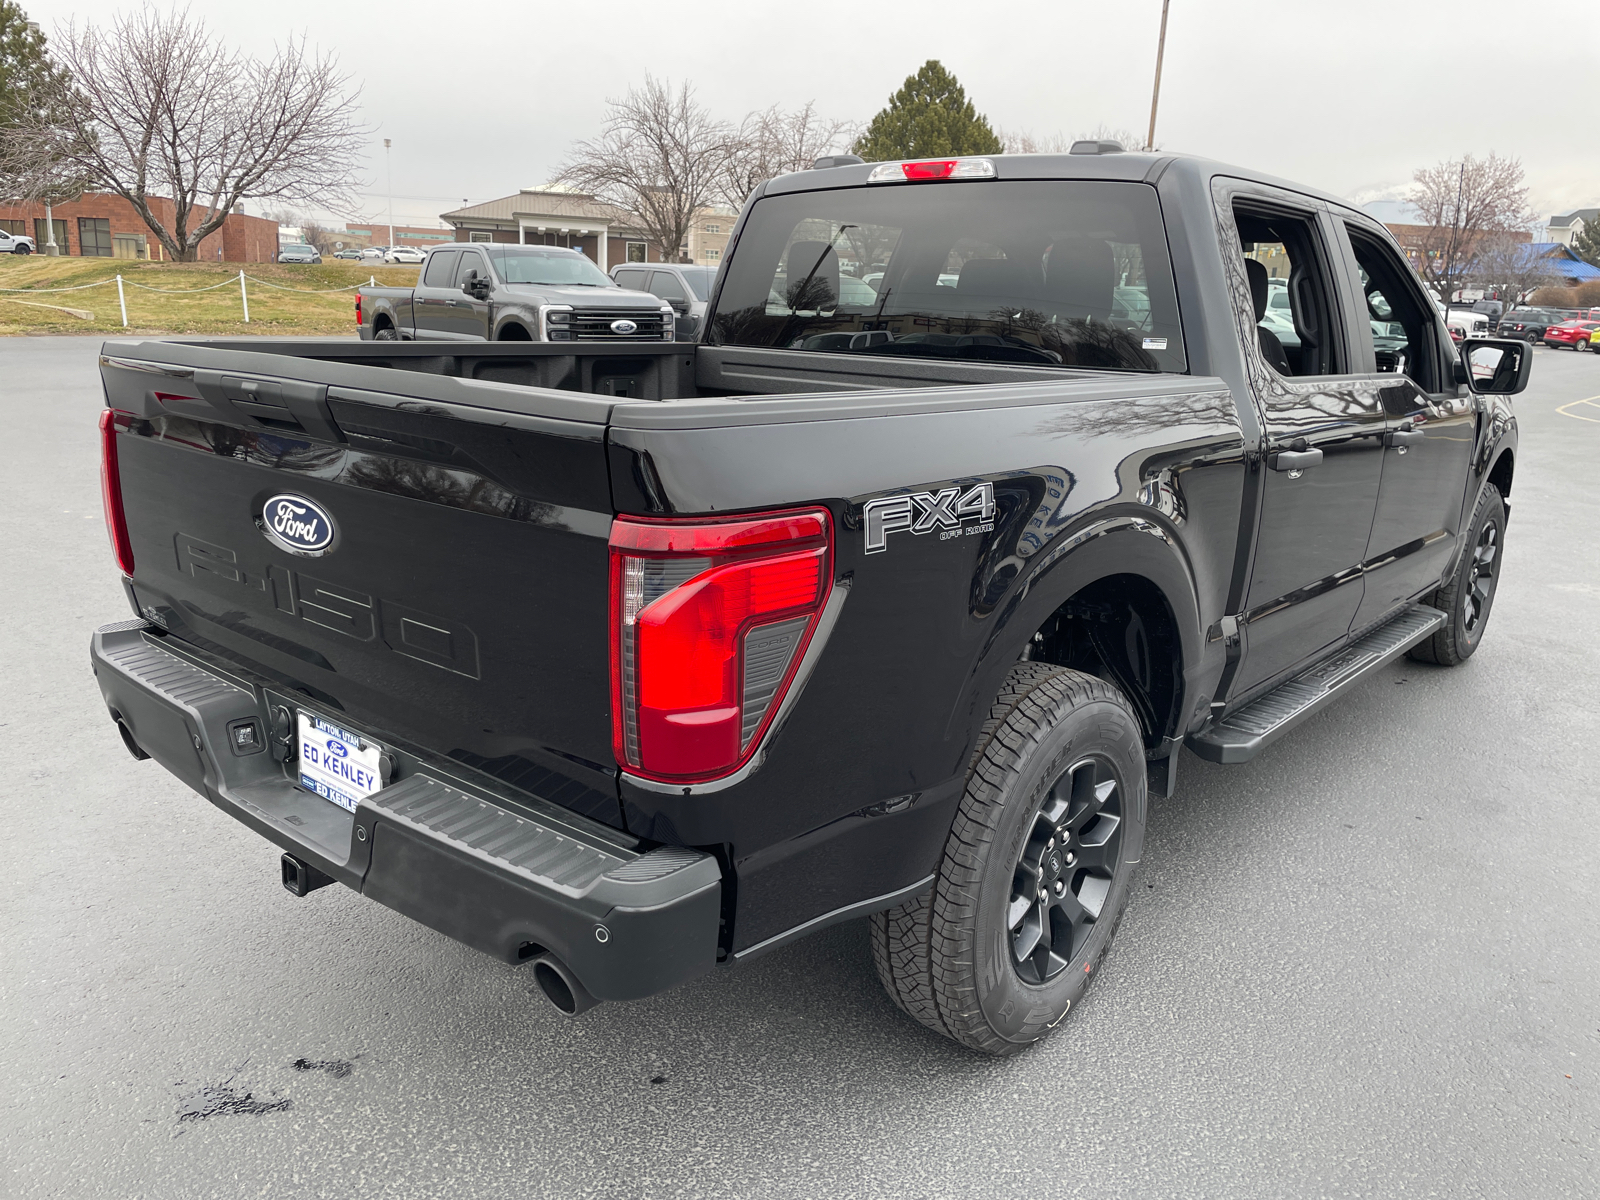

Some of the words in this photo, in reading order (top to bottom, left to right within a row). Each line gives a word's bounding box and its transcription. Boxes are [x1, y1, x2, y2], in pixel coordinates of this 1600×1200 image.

[274, 501, 318, 543] Ford
[863, 482, 996, 555] FX4
[940, 529, 962, 540] OFF
[965, 523, 995, 536] ROAD
[173, 531, 482, 680] F-150
[746, 636, 790, 651] FORD
[330, 741, 345, 757] Ford
[341, 730, 359, 748] UTAH
[303, 742, 319, 764] ED
[323, 752, 374, 792] KENLEY
[316, 781, 329, 798] ED
[329, 788, 357, 813] KENLE
